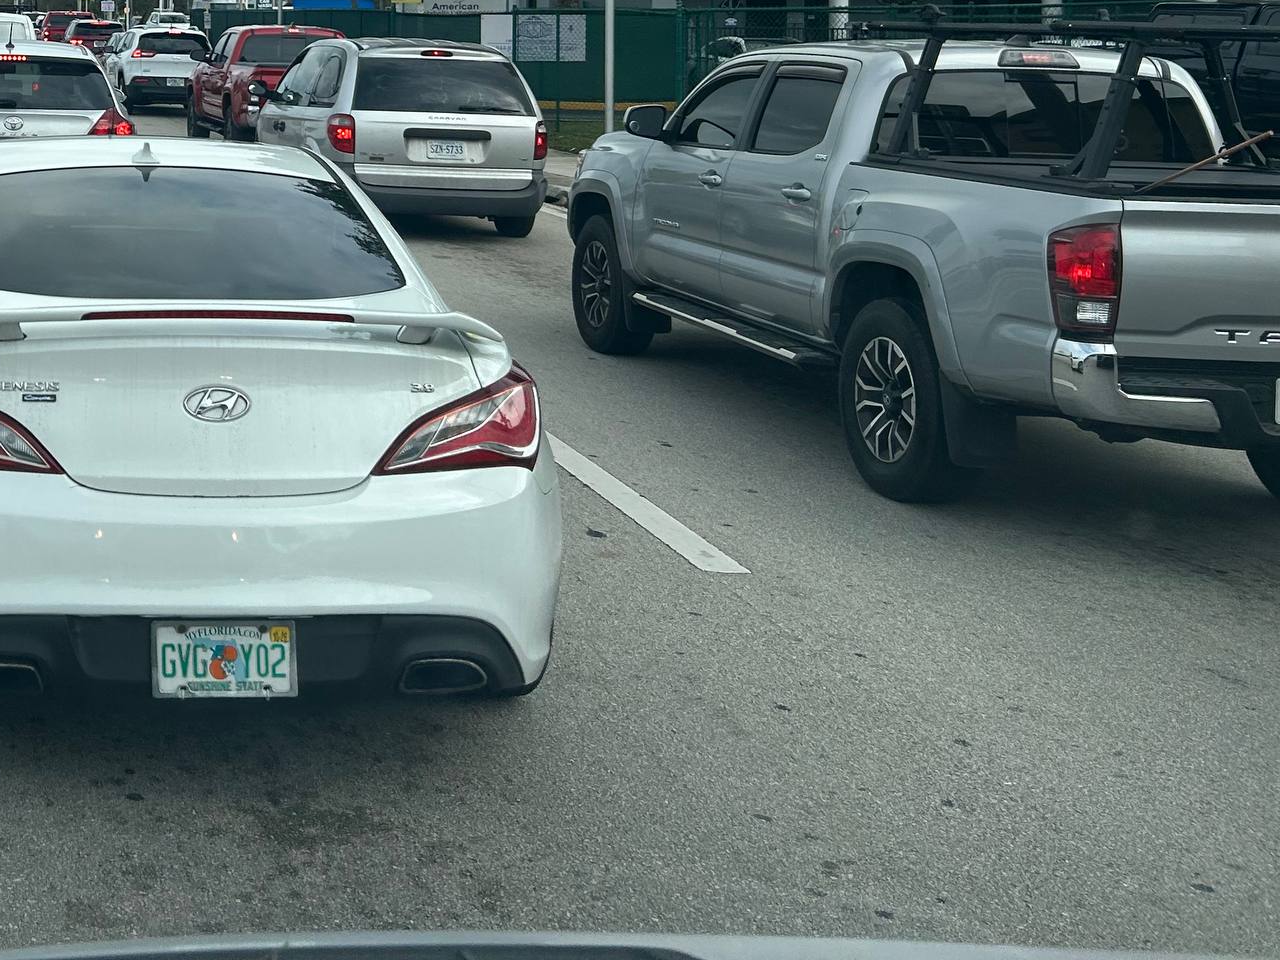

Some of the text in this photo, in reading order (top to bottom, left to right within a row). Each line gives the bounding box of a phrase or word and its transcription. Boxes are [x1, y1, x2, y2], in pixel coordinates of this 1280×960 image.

[432, 2, 479, 10] American
[430, 144, 464, 156] SZN-5733
[184, 626, 264, 641] MYFLORIDA.COM
[161, 643, 209, 678] GVG
